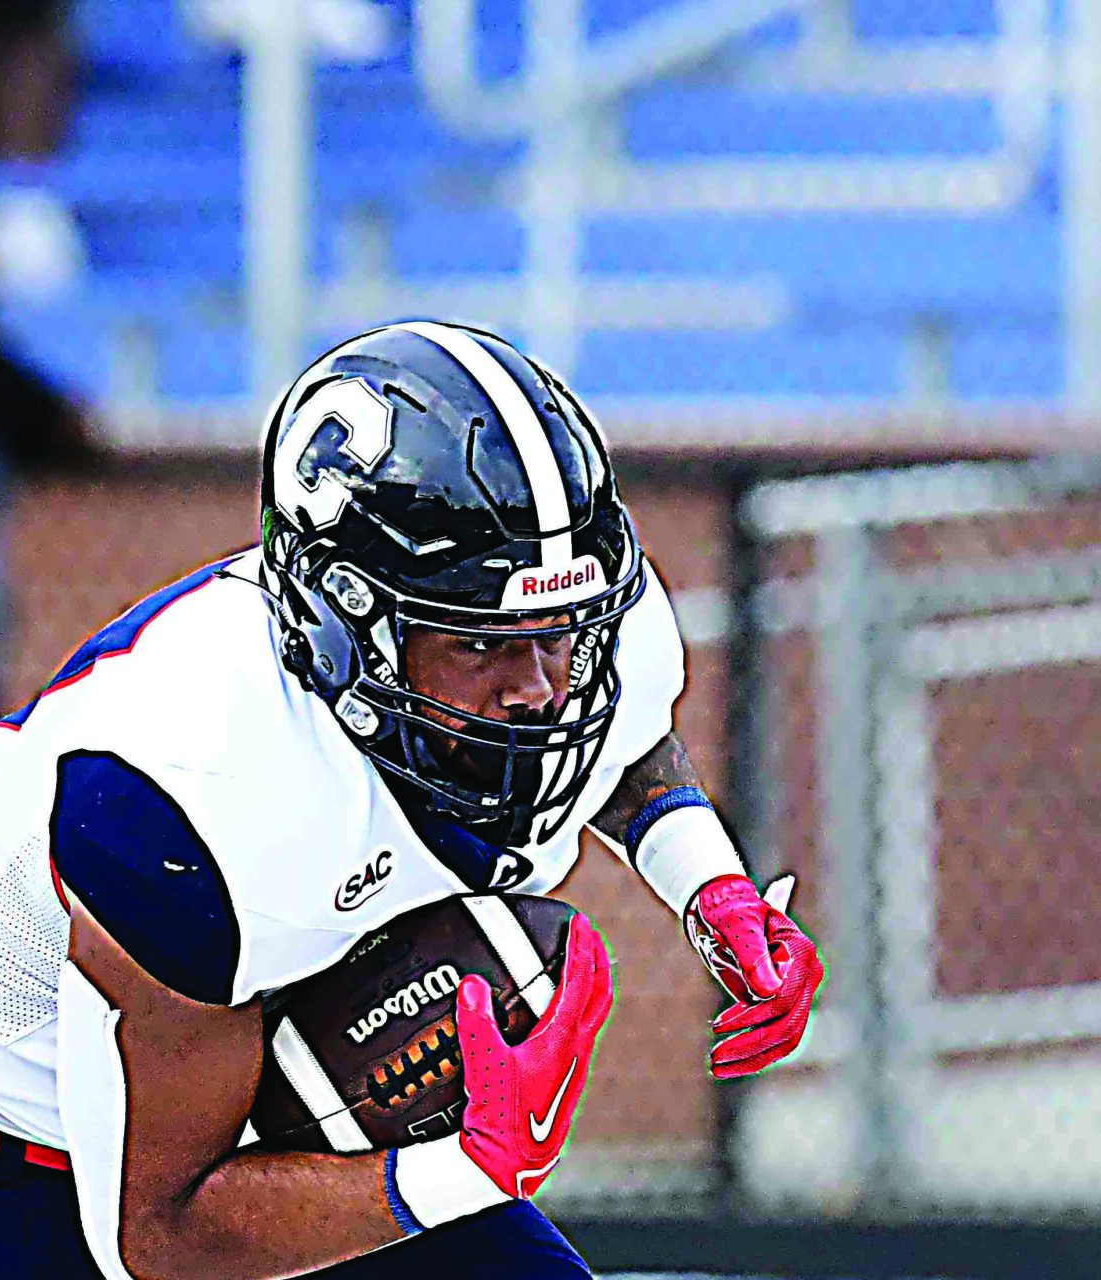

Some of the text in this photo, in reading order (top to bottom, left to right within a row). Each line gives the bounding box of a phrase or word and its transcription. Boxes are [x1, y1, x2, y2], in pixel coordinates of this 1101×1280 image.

[274, 376, 394, 533] C
[521, 561, 596, 596] Riddell
[342, 849, 393, 904] SAC
[346, 964, 461, 1044] Wilson
